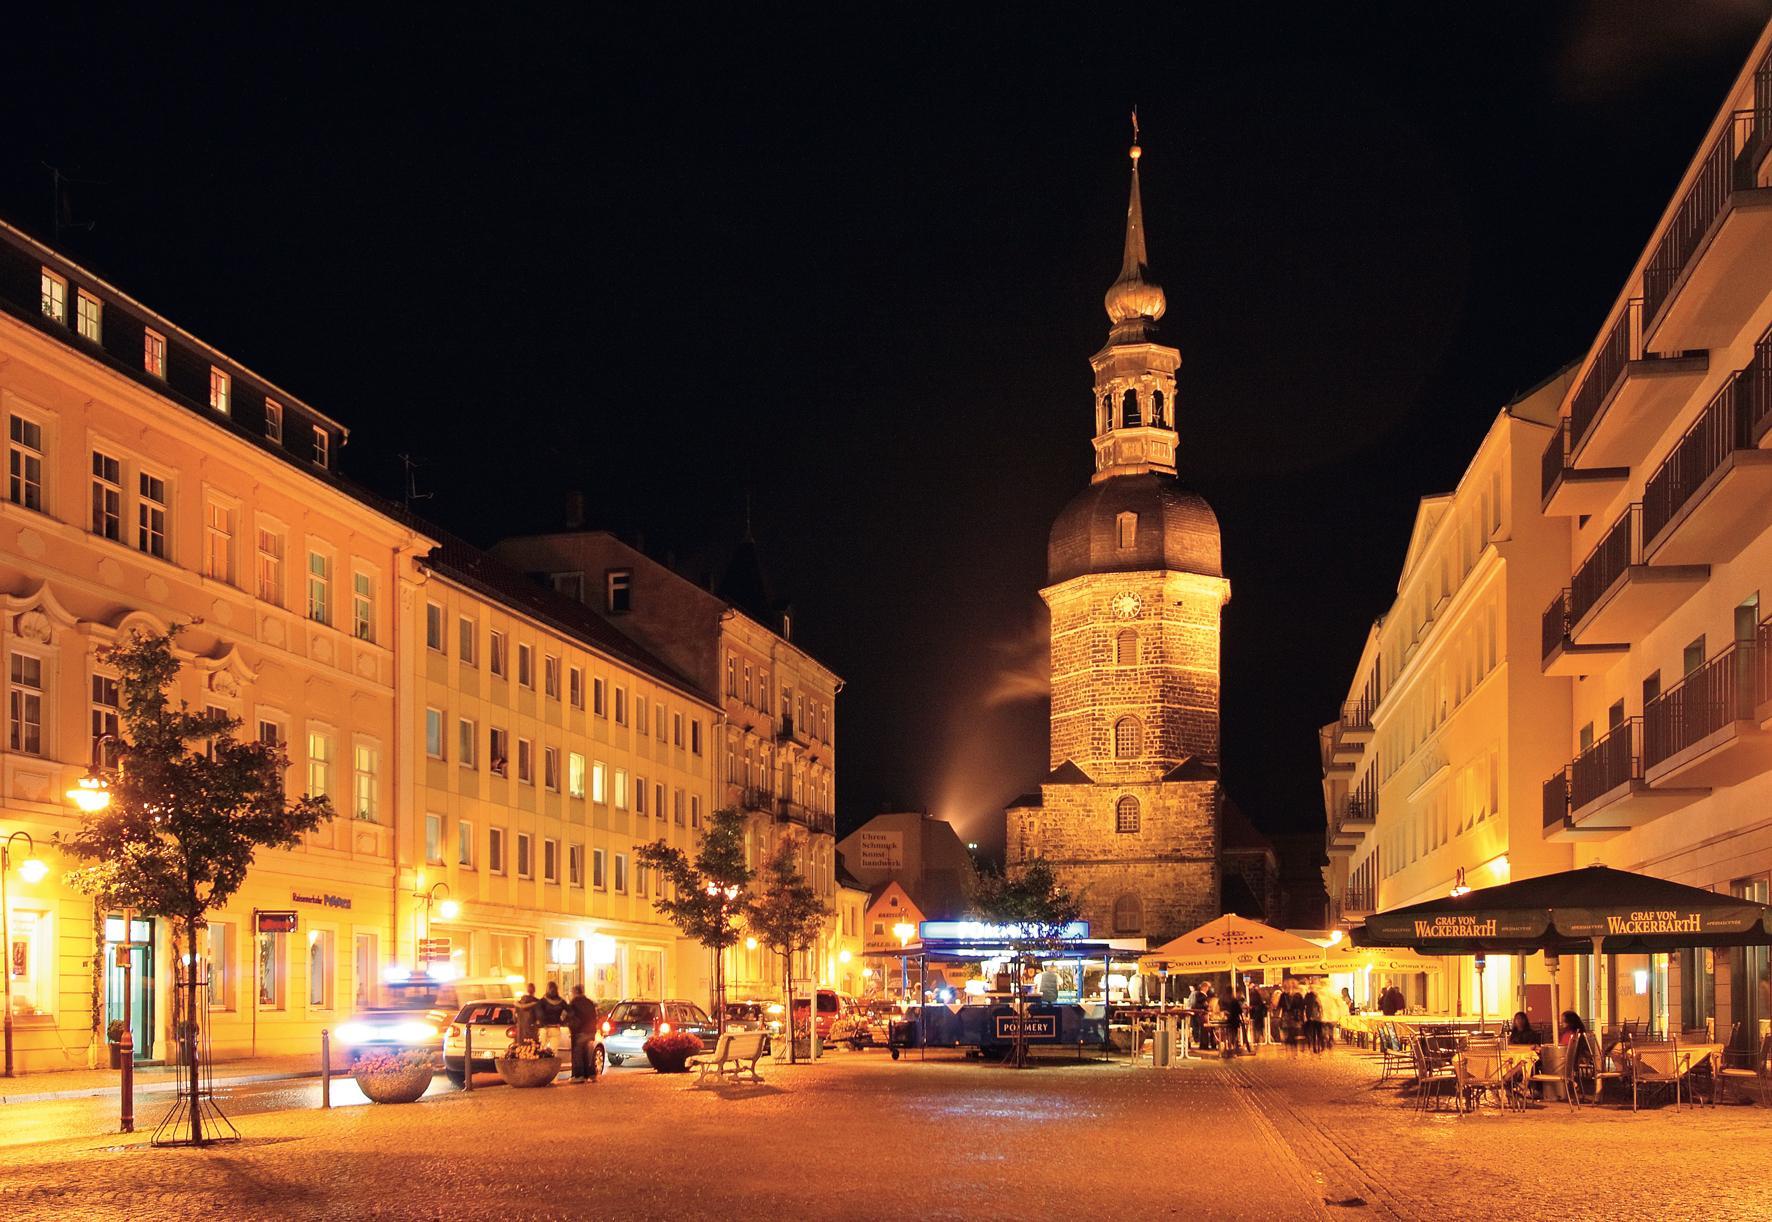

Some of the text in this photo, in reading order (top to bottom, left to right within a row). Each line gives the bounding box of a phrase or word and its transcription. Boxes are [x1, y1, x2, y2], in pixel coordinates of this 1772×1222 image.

[1435, 916, 1476, 925] GRAF VON
[1630, 910, 1677, 921] GRAF VON
[1414, 919, 1497, 938] WACKERBARTH
[1607, 913, 1701, 934] WACKERBARTH
[1196, 935, 1264, 945] Corona
[1258, 953, 1296, 964] Corona
